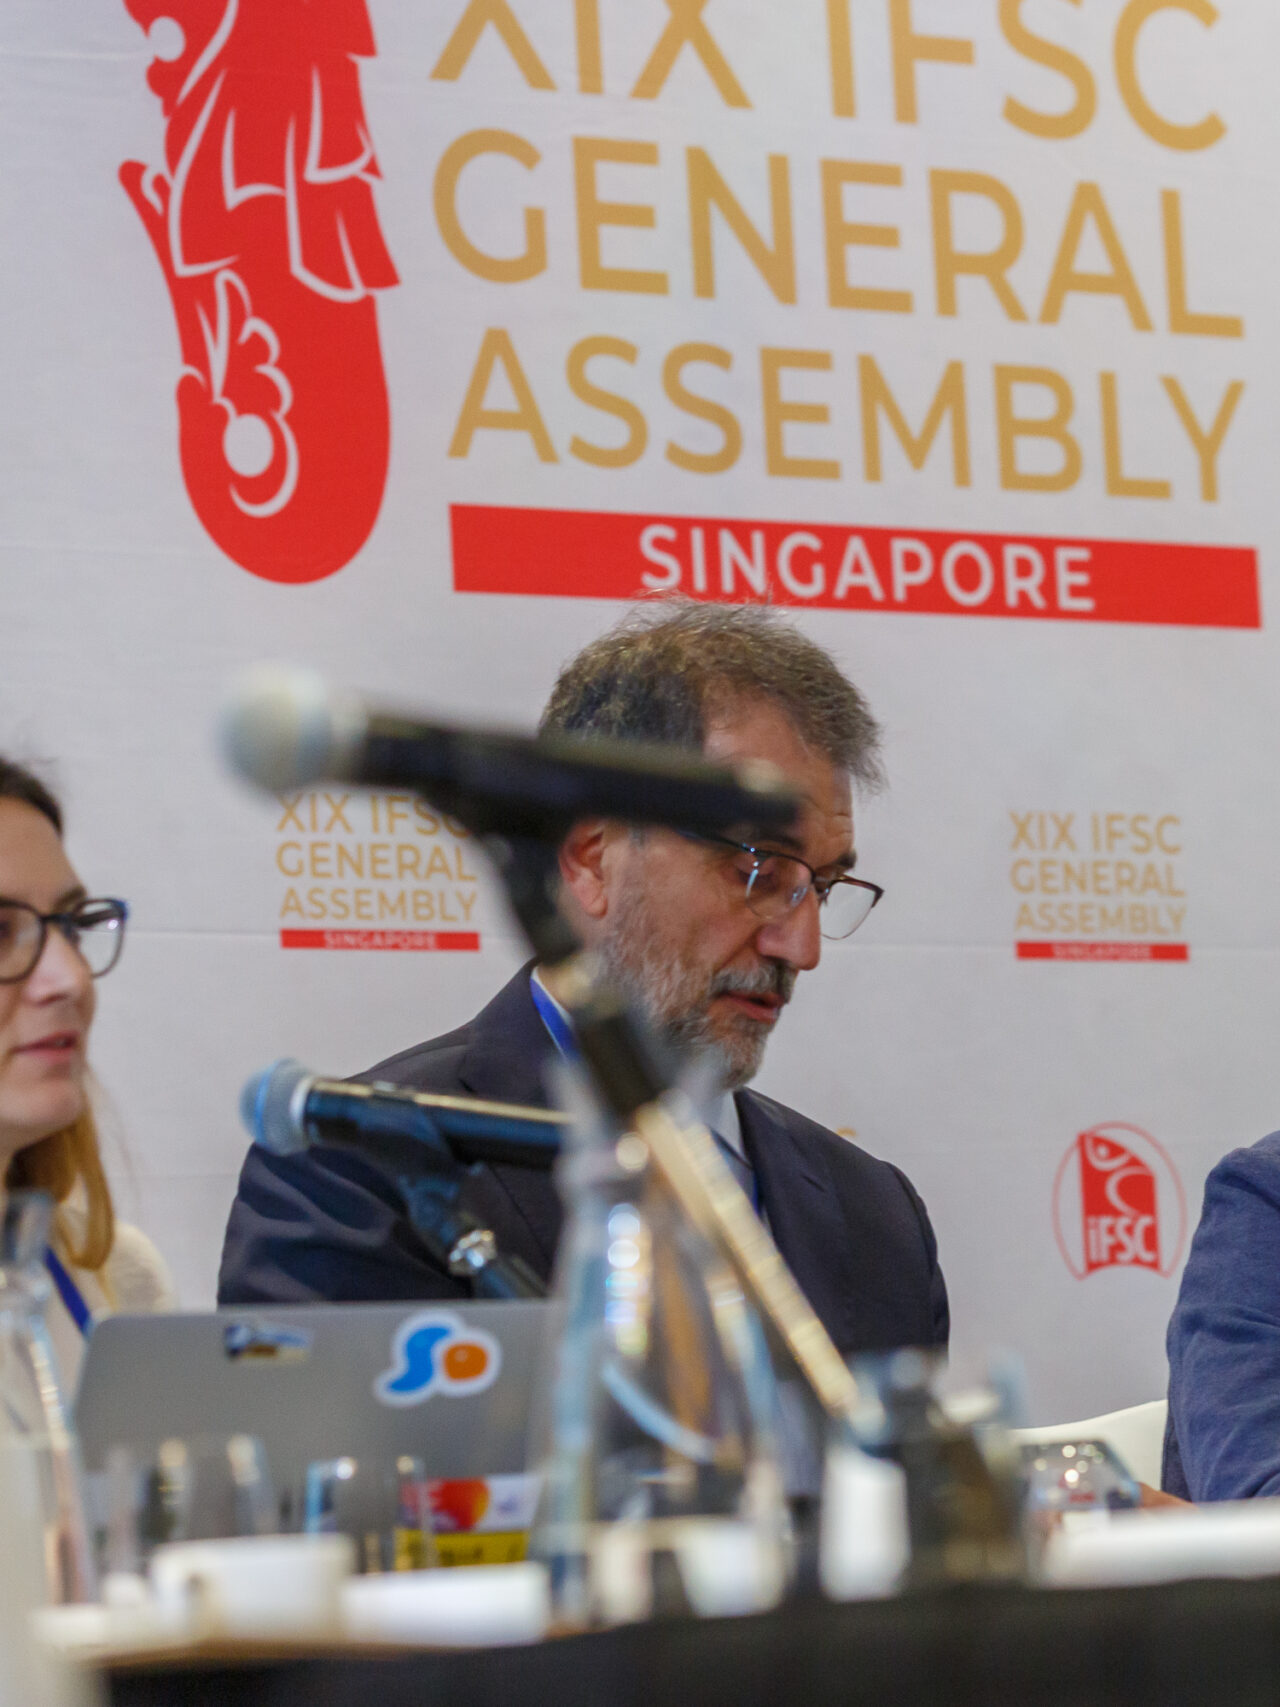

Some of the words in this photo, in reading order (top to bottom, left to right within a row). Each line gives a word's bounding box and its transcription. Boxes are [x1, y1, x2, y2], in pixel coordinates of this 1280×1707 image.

[825, 0, 1228, 153] IFSC
[433, 128, 1245, 339] GENERAL
[447, 327, 1246, 503] ASSEMBLY
[639, 524, 1096, 612] SINGAPORE
[276, 793, 353, 834] XIX
[1008, 811, 1078, 853] XIX
[1091, 812, 1183, 857] IFSC
[276, 841, 478, 883] GENERAL
[1010, 857, 1187, 899] GENERAL
[279, 887, 478, 923] ASSEMBLY
[1015, 901, 1188, 936] ASSEMBLY
[1088, 1215, 1157, 1264] IFSC
